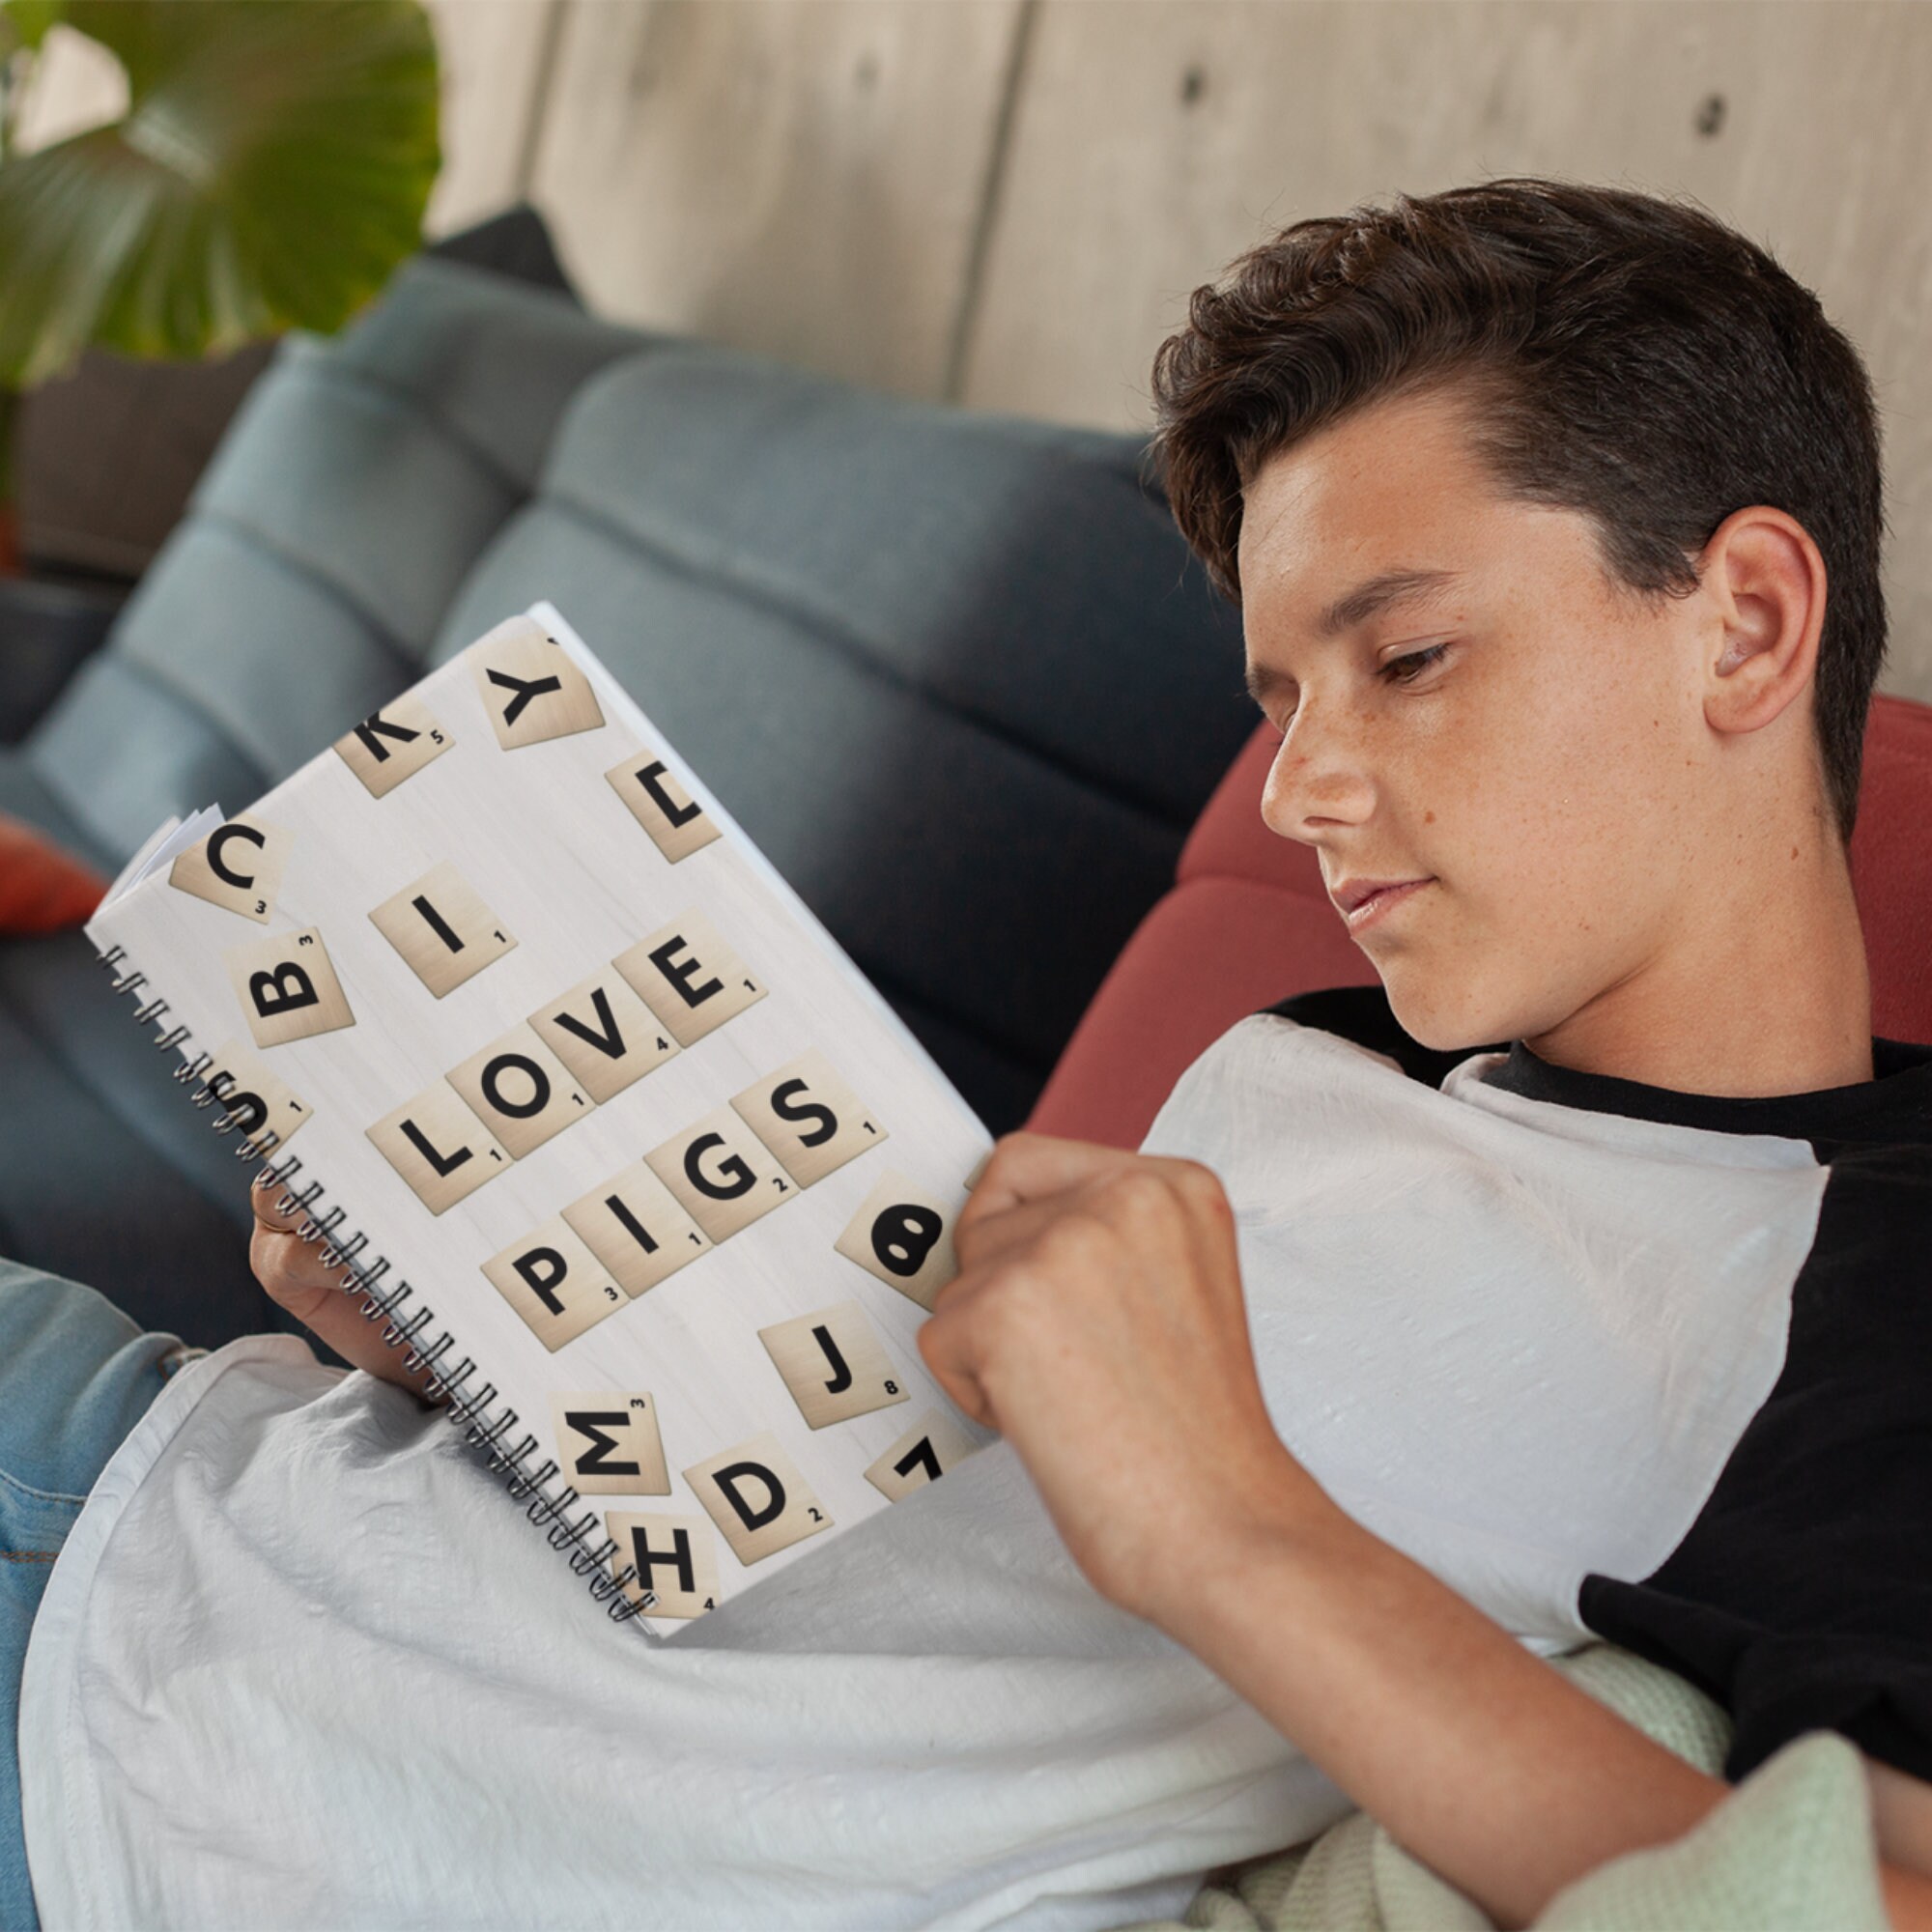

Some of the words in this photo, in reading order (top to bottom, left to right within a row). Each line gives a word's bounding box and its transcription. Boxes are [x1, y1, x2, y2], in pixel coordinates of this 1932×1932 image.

[486, 668, 562, 727] Y
[430, 729, 443, 745] 5
[206, 823, 266, 890] C
[255, 900, 267, 915] 3
[412, 895, 465, 953] I
[298, 935, 314, 946] 3
[494, 930, 506, 943] 1
[248, 961, 320, 1018] B
[743, 980, 756, 992] 1
[656, 1037, 668, 1051] 4
[399, 935, 724, 1178] LOVE
[289, 1100, 302, 1112] 1
[572, 1094, 584, 1106] 1
[863, 1122, 876, 1134] 1
[490, 1149, 502, 1161] 1
[772, 1178, 788, 1192] 2
[512, 1078, 838, 1316] PIGS
[688, 1233, 701, 1245] 1
[604, 1287, 618, 1301] 3
[811, 1324, 853, 1394] J
[884, 1379, 899, 1396] 8
[630, 1398, 645, 1408] 3
[564, 1411, 640, 1476] M
[711, 1462, 786, 1532] D
[808, 1507, 823, 1522] 2
[631, 1526, 696, 1593] H
[703, 1597, 716, 1611] 4
